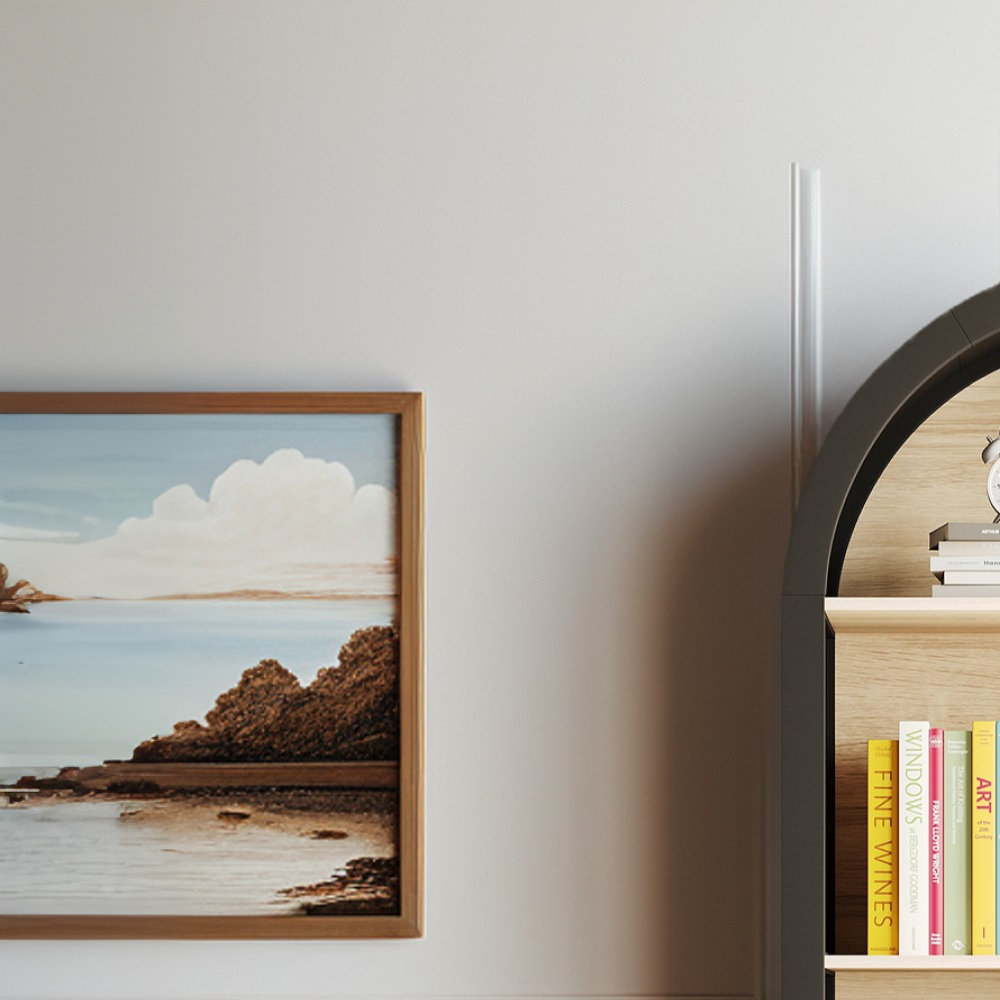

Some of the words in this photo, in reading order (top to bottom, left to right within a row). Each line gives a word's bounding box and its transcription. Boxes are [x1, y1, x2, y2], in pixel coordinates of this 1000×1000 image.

[905, 729, 923, 824] WINDOWS
[976, 777, 992, 813] ART
[873, 770, 893, 827] FINE
[932, 800, 940, 826] FRANK
[909, 835, 918, 873] BERGDORF
[932, 827, 940, 851] LLOYD
[873, 840, 893, 928] WINES
[932, 852, 940, 884] WRIGHT
[909, 874, 918, 913] GOODMAN
